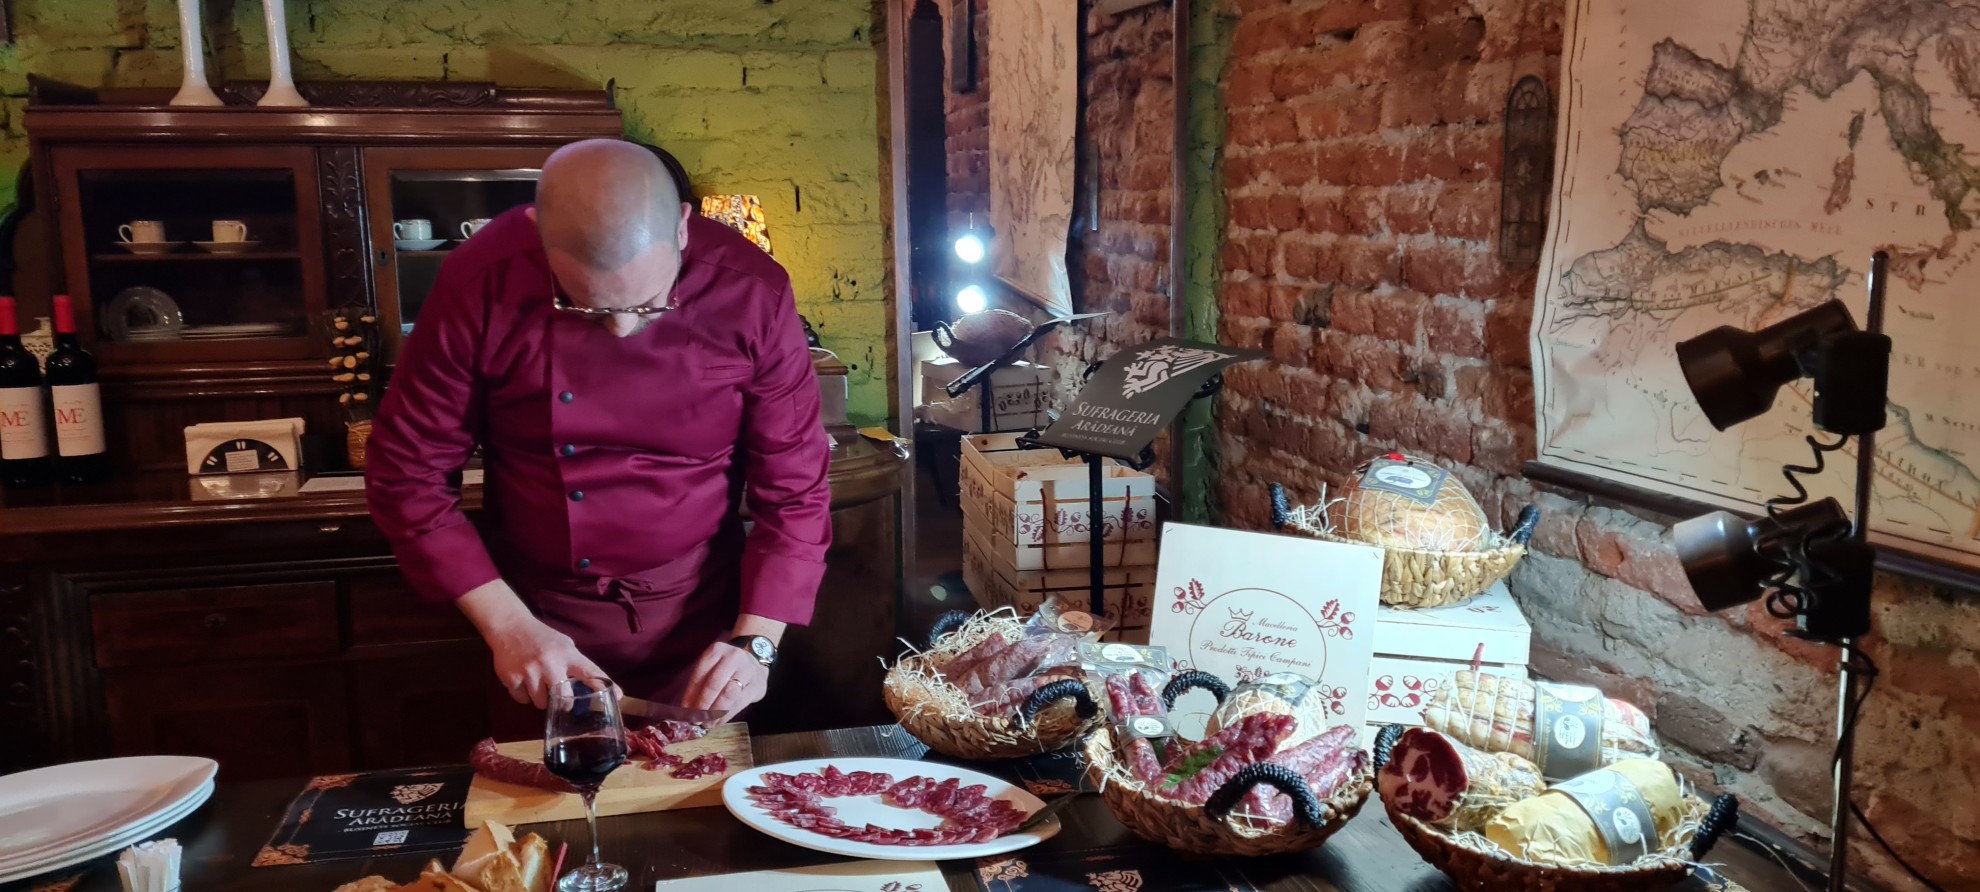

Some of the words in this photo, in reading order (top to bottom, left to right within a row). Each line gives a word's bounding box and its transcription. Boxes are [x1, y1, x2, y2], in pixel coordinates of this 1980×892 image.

[1072, 402, 1161, 425] SUFRAGERIA
[1219, 620, 1297, 648] Barone
[1199, 639, 1237, 656] Prodotti
[1239, 646, 1267, 661] Tipici
[1269, 651, 1311, 668] Campani
